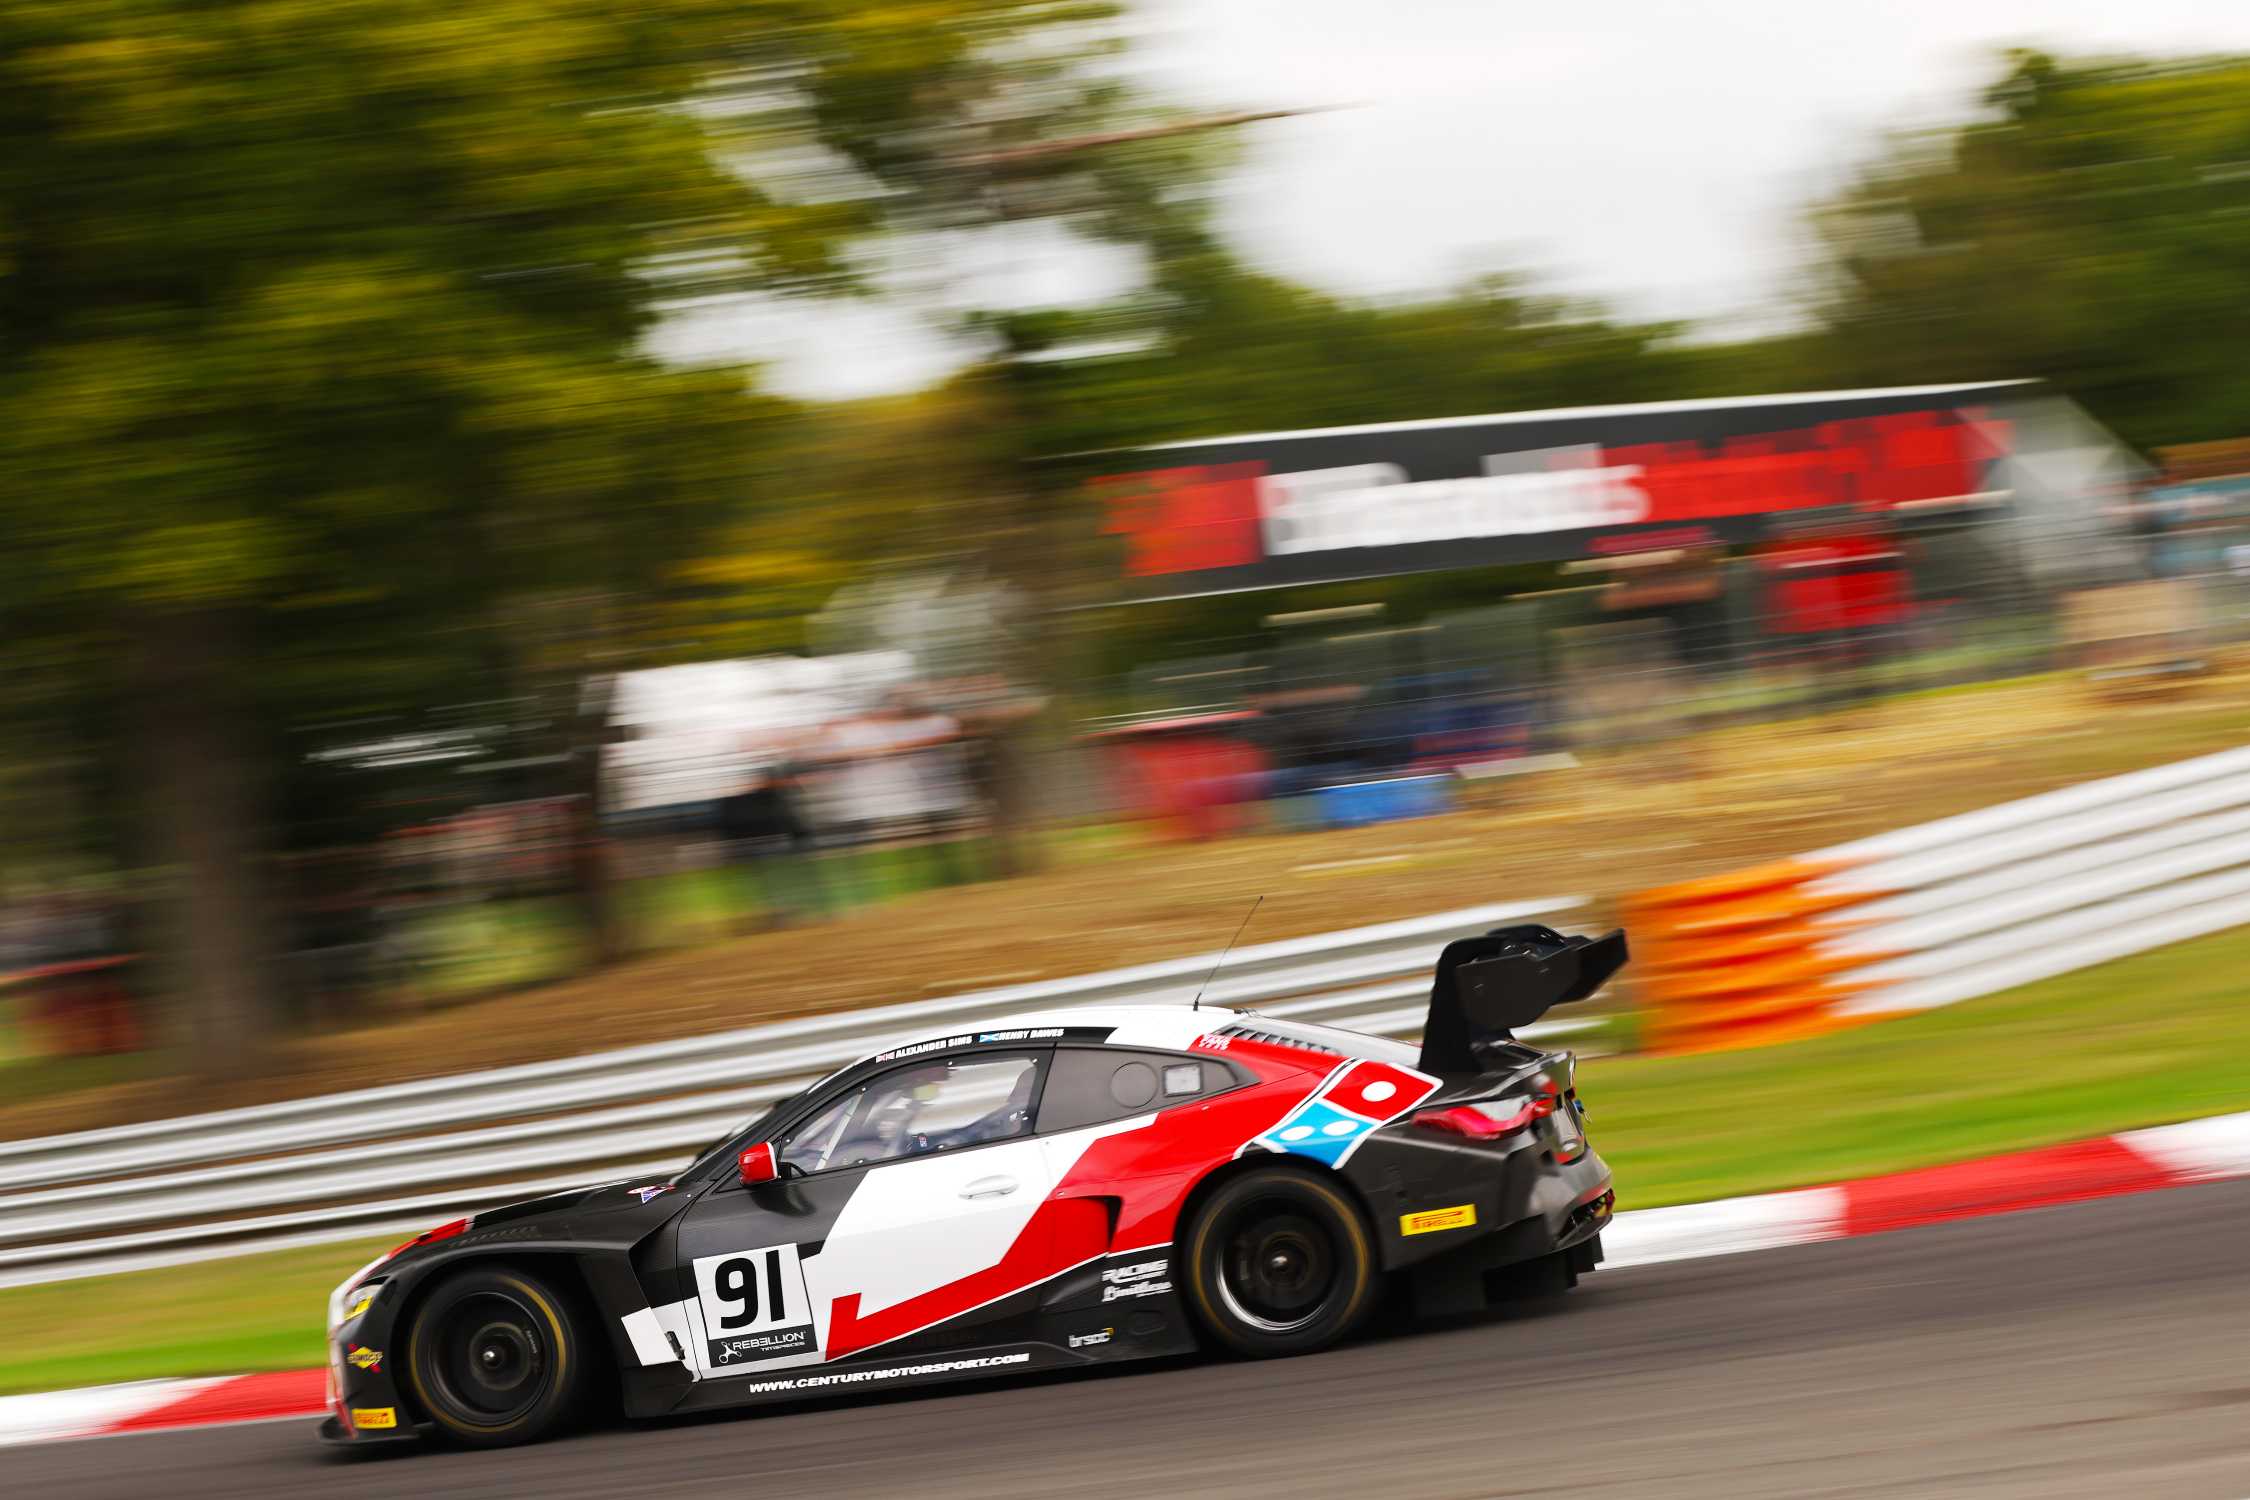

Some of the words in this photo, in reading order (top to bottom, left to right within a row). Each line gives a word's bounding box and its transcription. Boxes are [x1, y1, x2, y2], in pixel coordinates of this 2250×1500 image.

[896, 1040, 947, 1059] ALEXANDER
[948, 1036, 973, 1048] SIMS
[715, 1249, 785, 1330] 91
[749, 1353, 1030, 1393] WWW.CENTURYMOTORSPORT.COM
